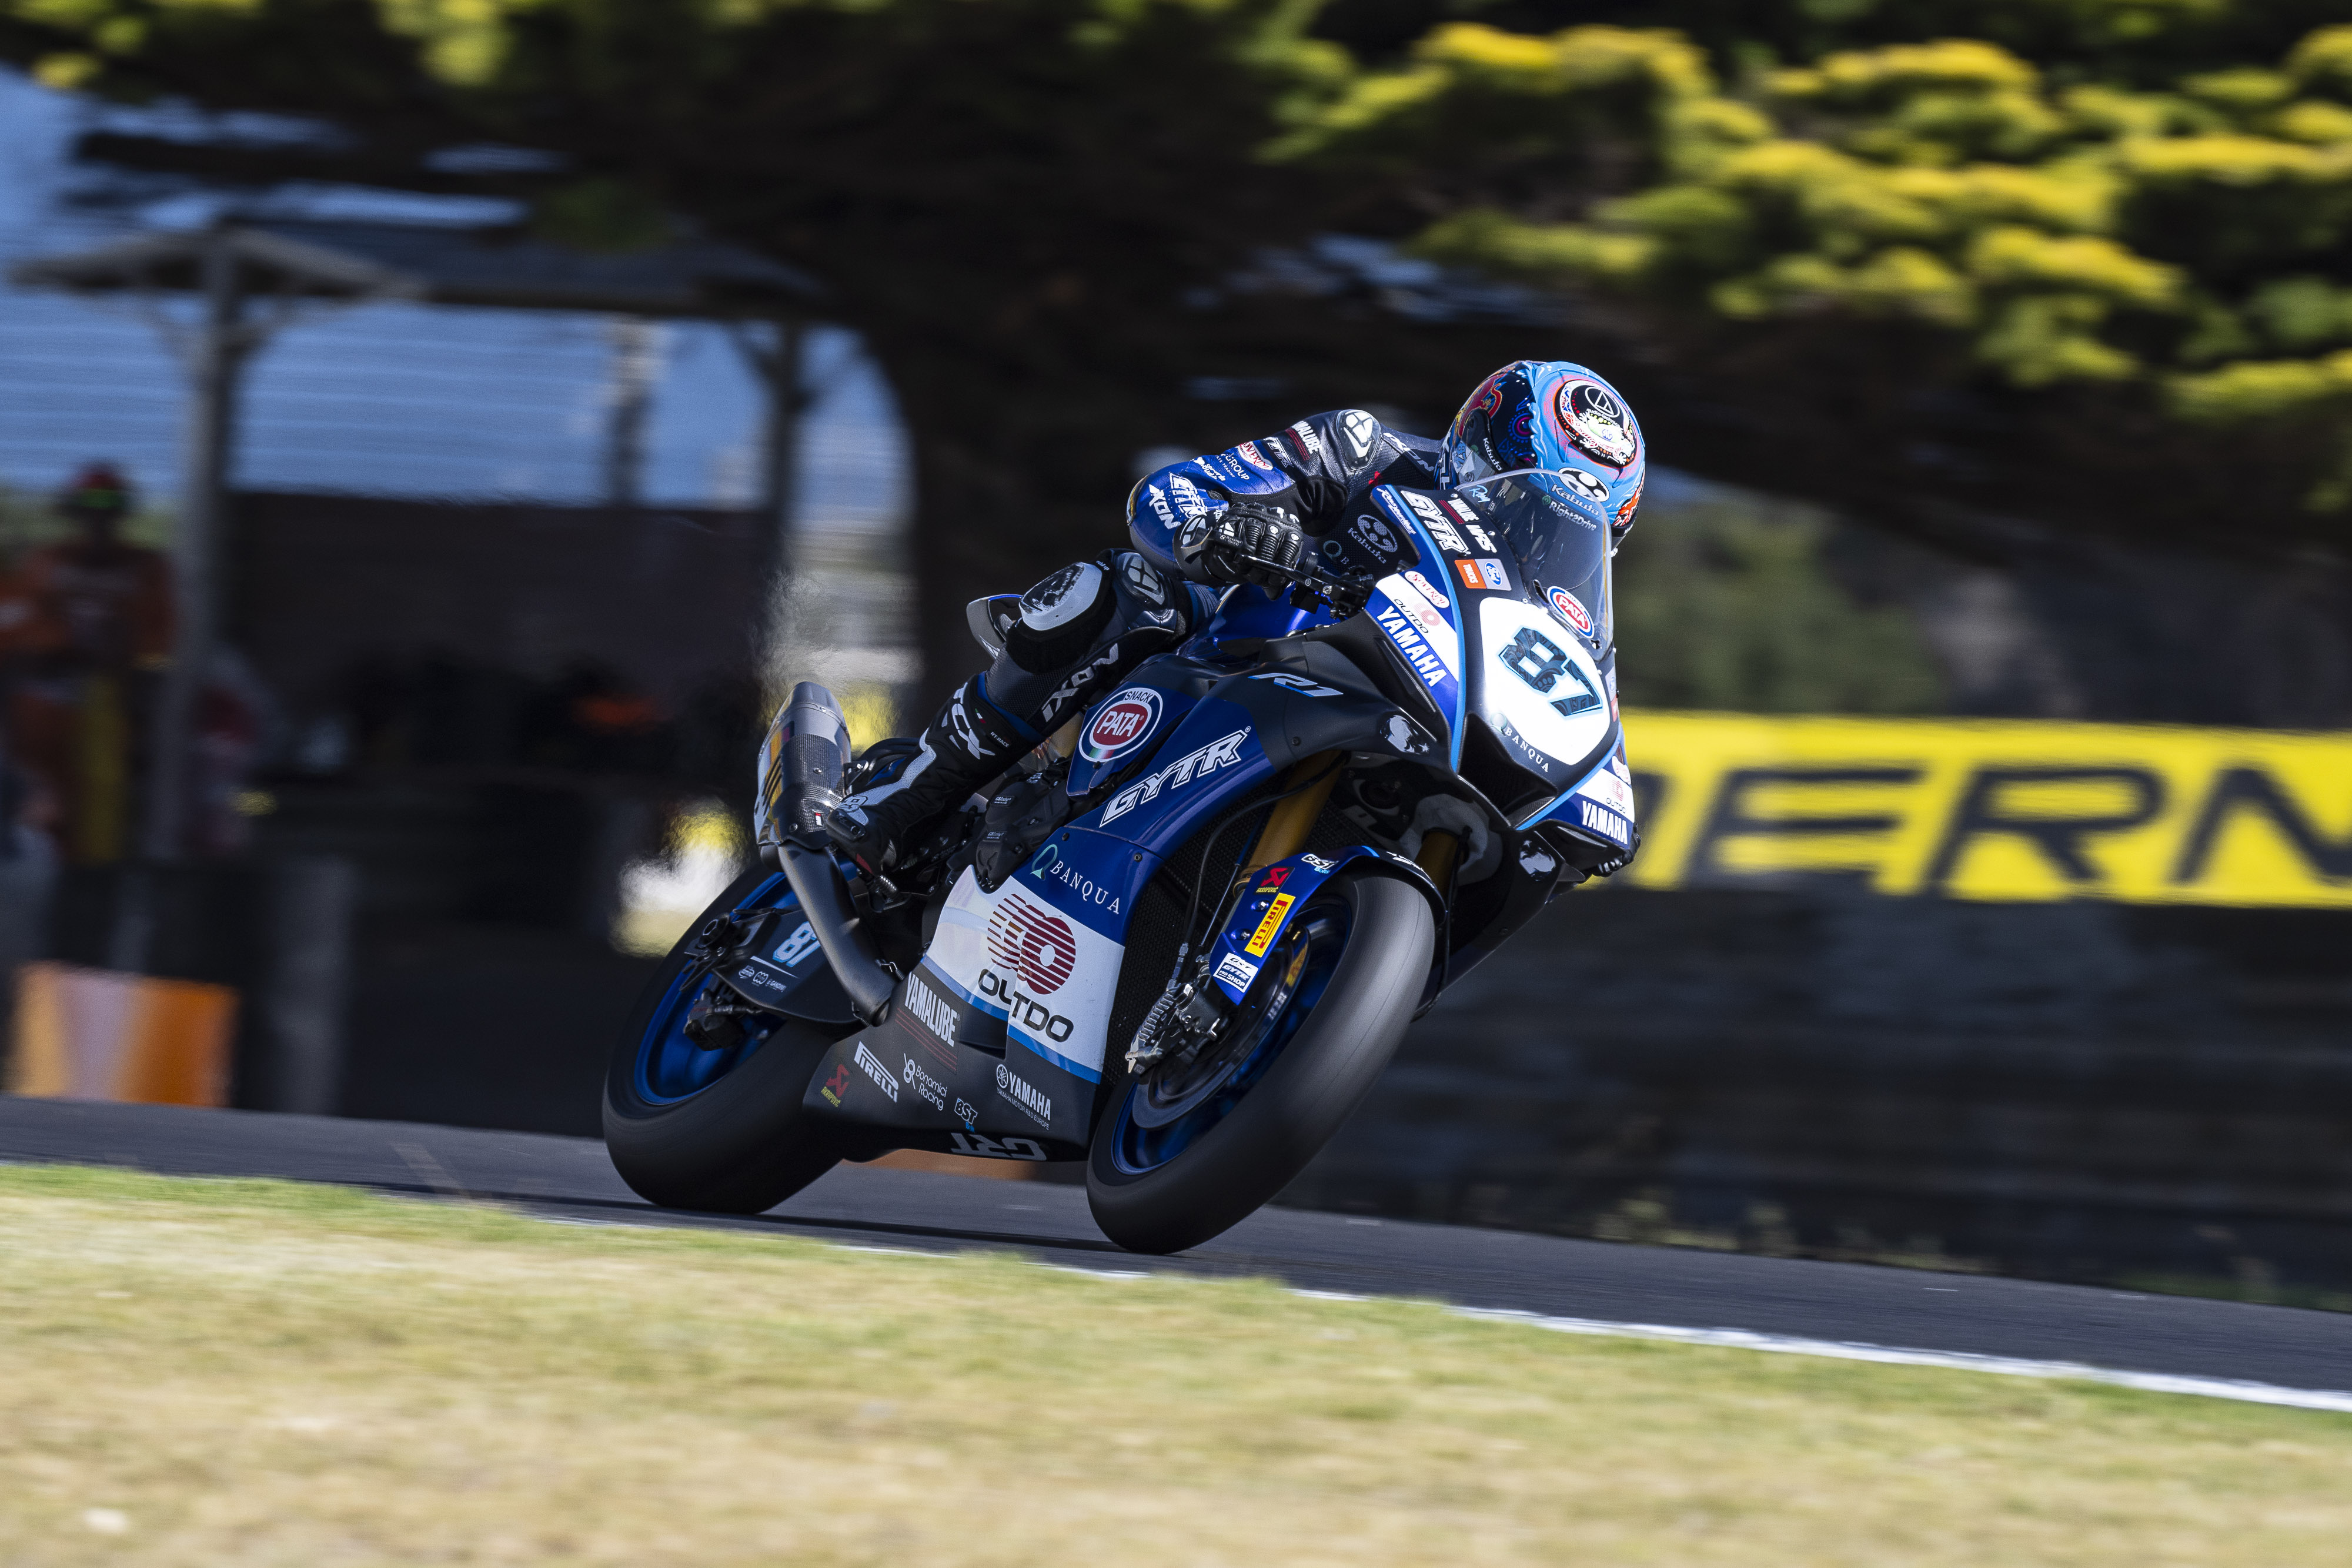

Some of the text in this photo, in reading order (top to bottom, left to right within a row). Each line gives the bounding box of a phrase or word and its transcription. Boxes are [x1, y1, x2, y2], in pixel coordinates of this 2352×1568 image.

[1240, 442, 1269, 469] OVERINI
[1483, 437, 1502, 471] Kabuto
[1548, 500, 1597, 531] Right2Drive
[1551, 483, 1599, 516] Kabuto
[1401, 490, 1469, 554] GYTR
[1347, 527, 1387, 564] Kabuto
[1462, 563, 1479, 584] TRUCKS
[1394, 599, 1429, 634] OUTDO
[1558, 595, 1587, 628] PATA
[1377, 605, 1447, 687] YAMAHA
[1497, 626, 1603, 717] 87
[1124, 691, 1152, 704] SNACK
[990, 731, 1010, 748] RT-RACE
[1096, 710, 1140, 738] PATA
[1506, 727, 1549, 773] BANQUA
[1098, 728, 1248, 828] GYTR
[1582, 800, 1628, 845] YAMAHA
[1050, 860, 1120, 915] BANQUA
[1251, 899, 1289, 950] PIRELLI
[1221, 964, 1251, 981] GYTR
[1227, 973, 1246, 988] SHOP
[904, 971, 958, 1048] YAMALUBE
[978, 968, 1075, 1044] OUTDO
[854, 1041, 899, 1104] PIRELLI
[916, 1065, 948, 1098] Bonamici
[918, 1082, 944, 1111] Racing
[953, 1097, 978, 1125] BST
[997, 1086, 1011, 1104] YAMAHA
[1011, 1098, 1025, 1113] MOTOR
[1034, 1114, 1050, 1131] EUROPE
[1009, 1071, 1051, 1121] YAMAHA
